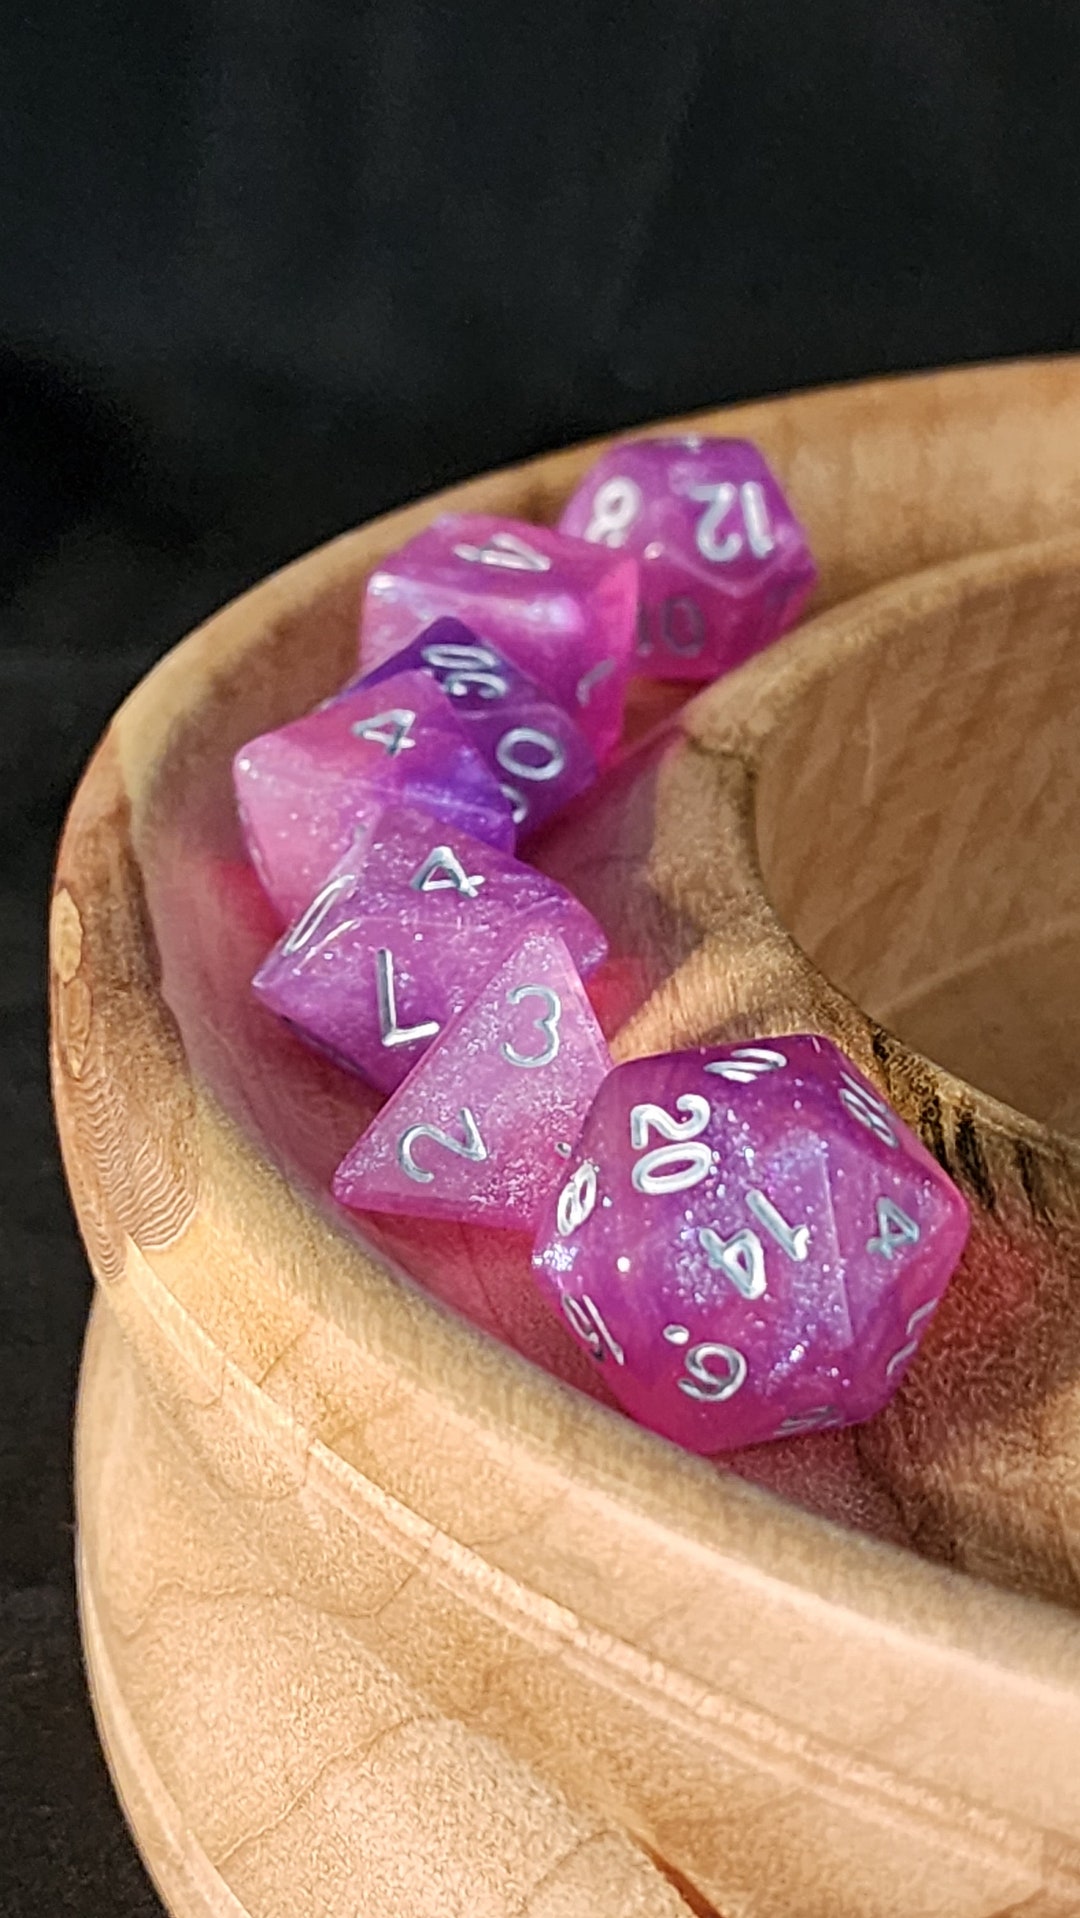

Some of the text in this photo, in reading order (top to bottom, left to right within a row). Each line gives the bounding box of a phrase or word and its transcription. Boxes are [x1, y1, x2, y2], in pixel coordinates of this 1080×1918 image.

[453, 533, 551, 571] 4
[690, 482, 776, 562] 12
[350, 709, 415, 758] 4
[409, 845, 486, 898] 4
[375, 947, 440, 1047] 7
[502, 983, 562, 1069] 3
[397, 1106, 488, 1184] 2
[630, 1093, 714, 1195] 20
[699, 1189, 811, 1300] 14
[866, 1196, 921, 1261] 4
